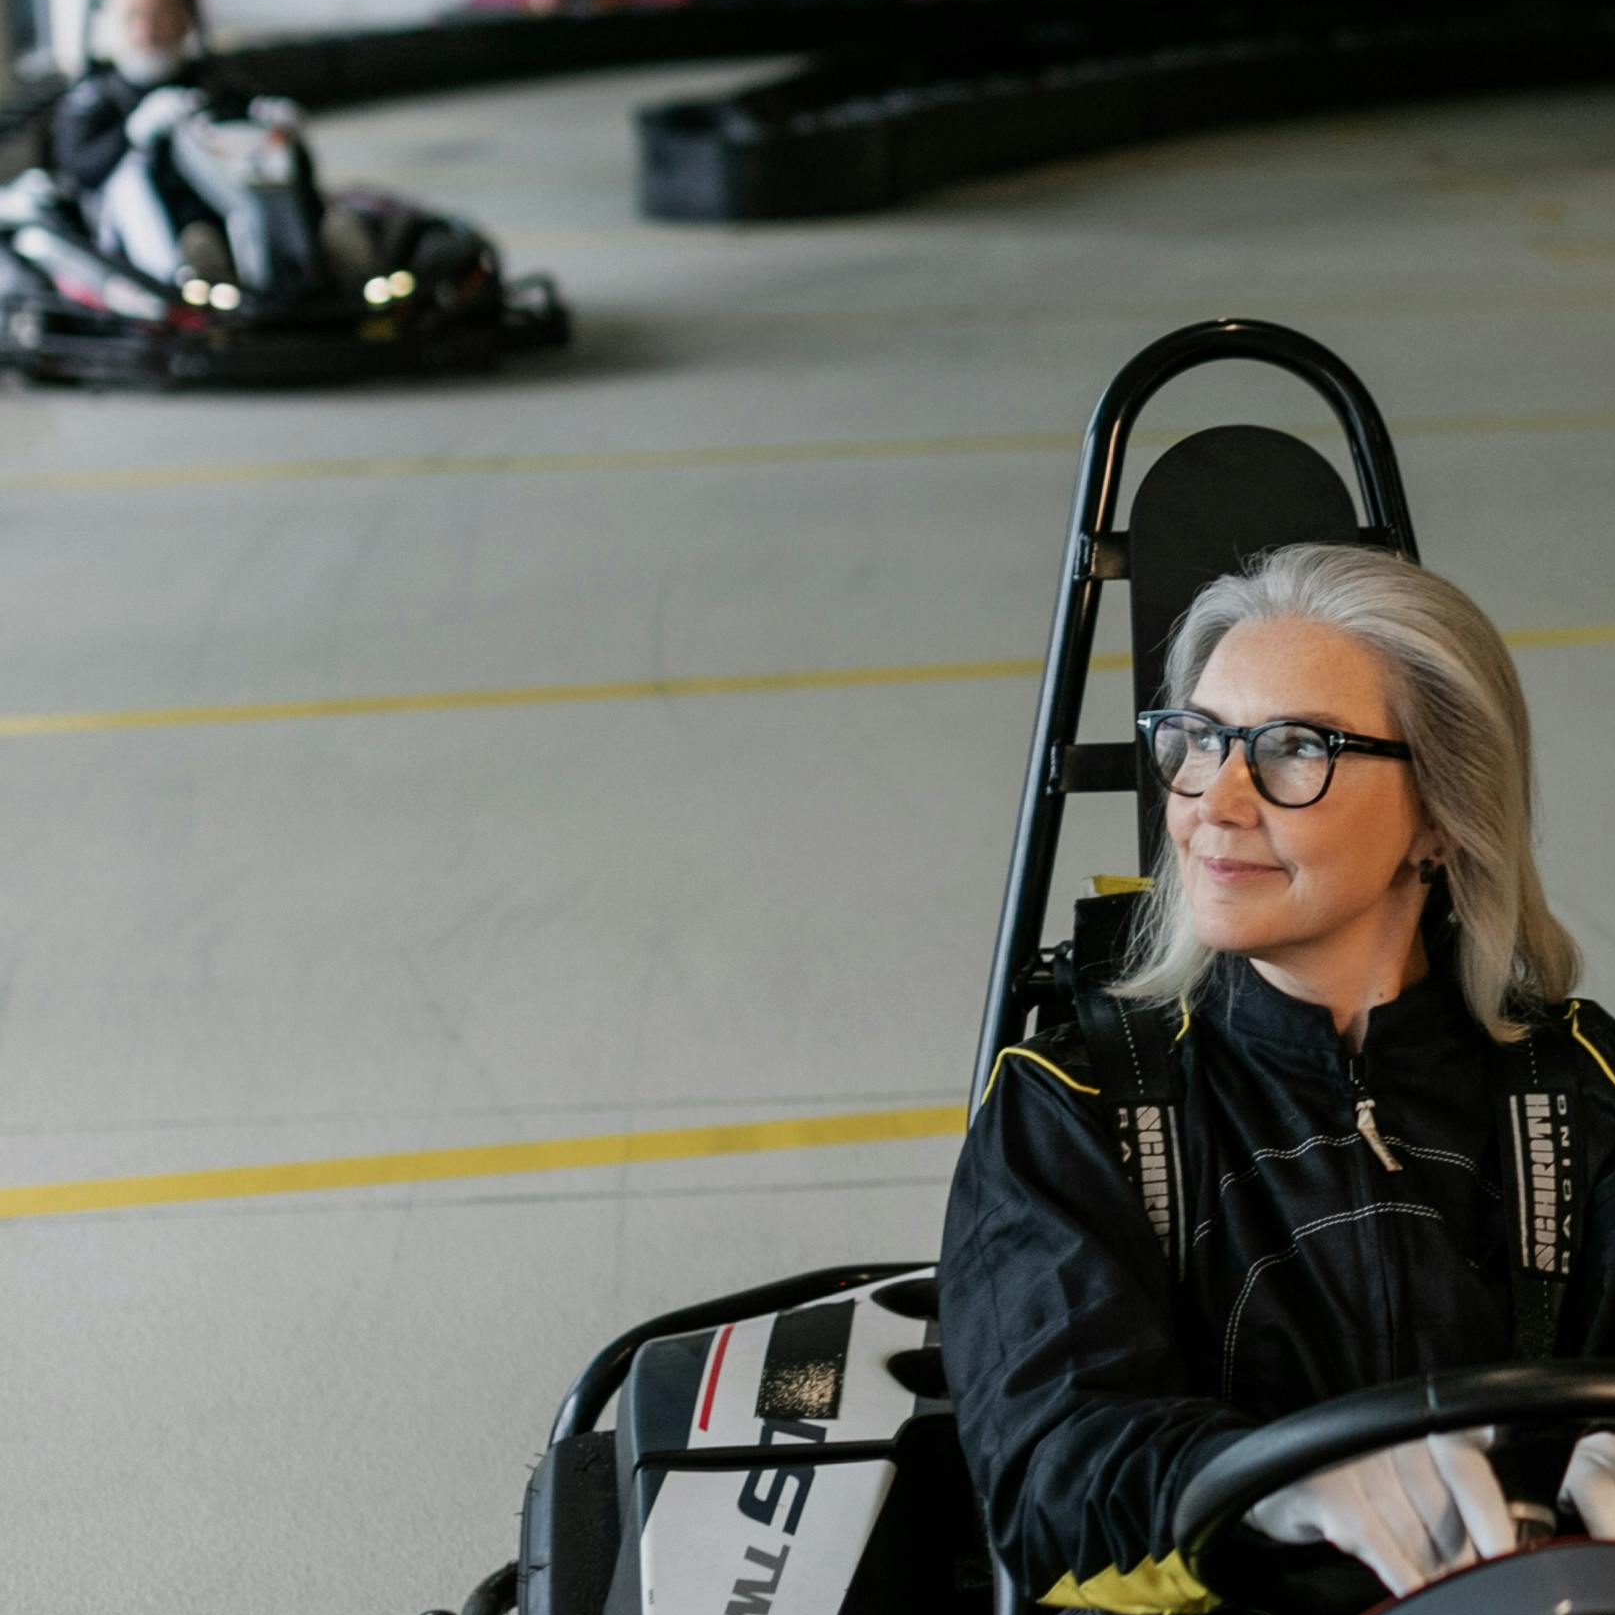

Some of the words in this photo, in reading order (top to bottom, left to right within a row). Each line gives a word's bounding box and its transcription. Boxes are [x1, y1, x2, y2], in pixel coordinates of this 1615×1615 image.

[1136, 1106, 1170, 1259] SCHRO
[1525, 1093, 1557, 1272] SCHROTH
[1557, 1094, 1573, 1274] RACING
